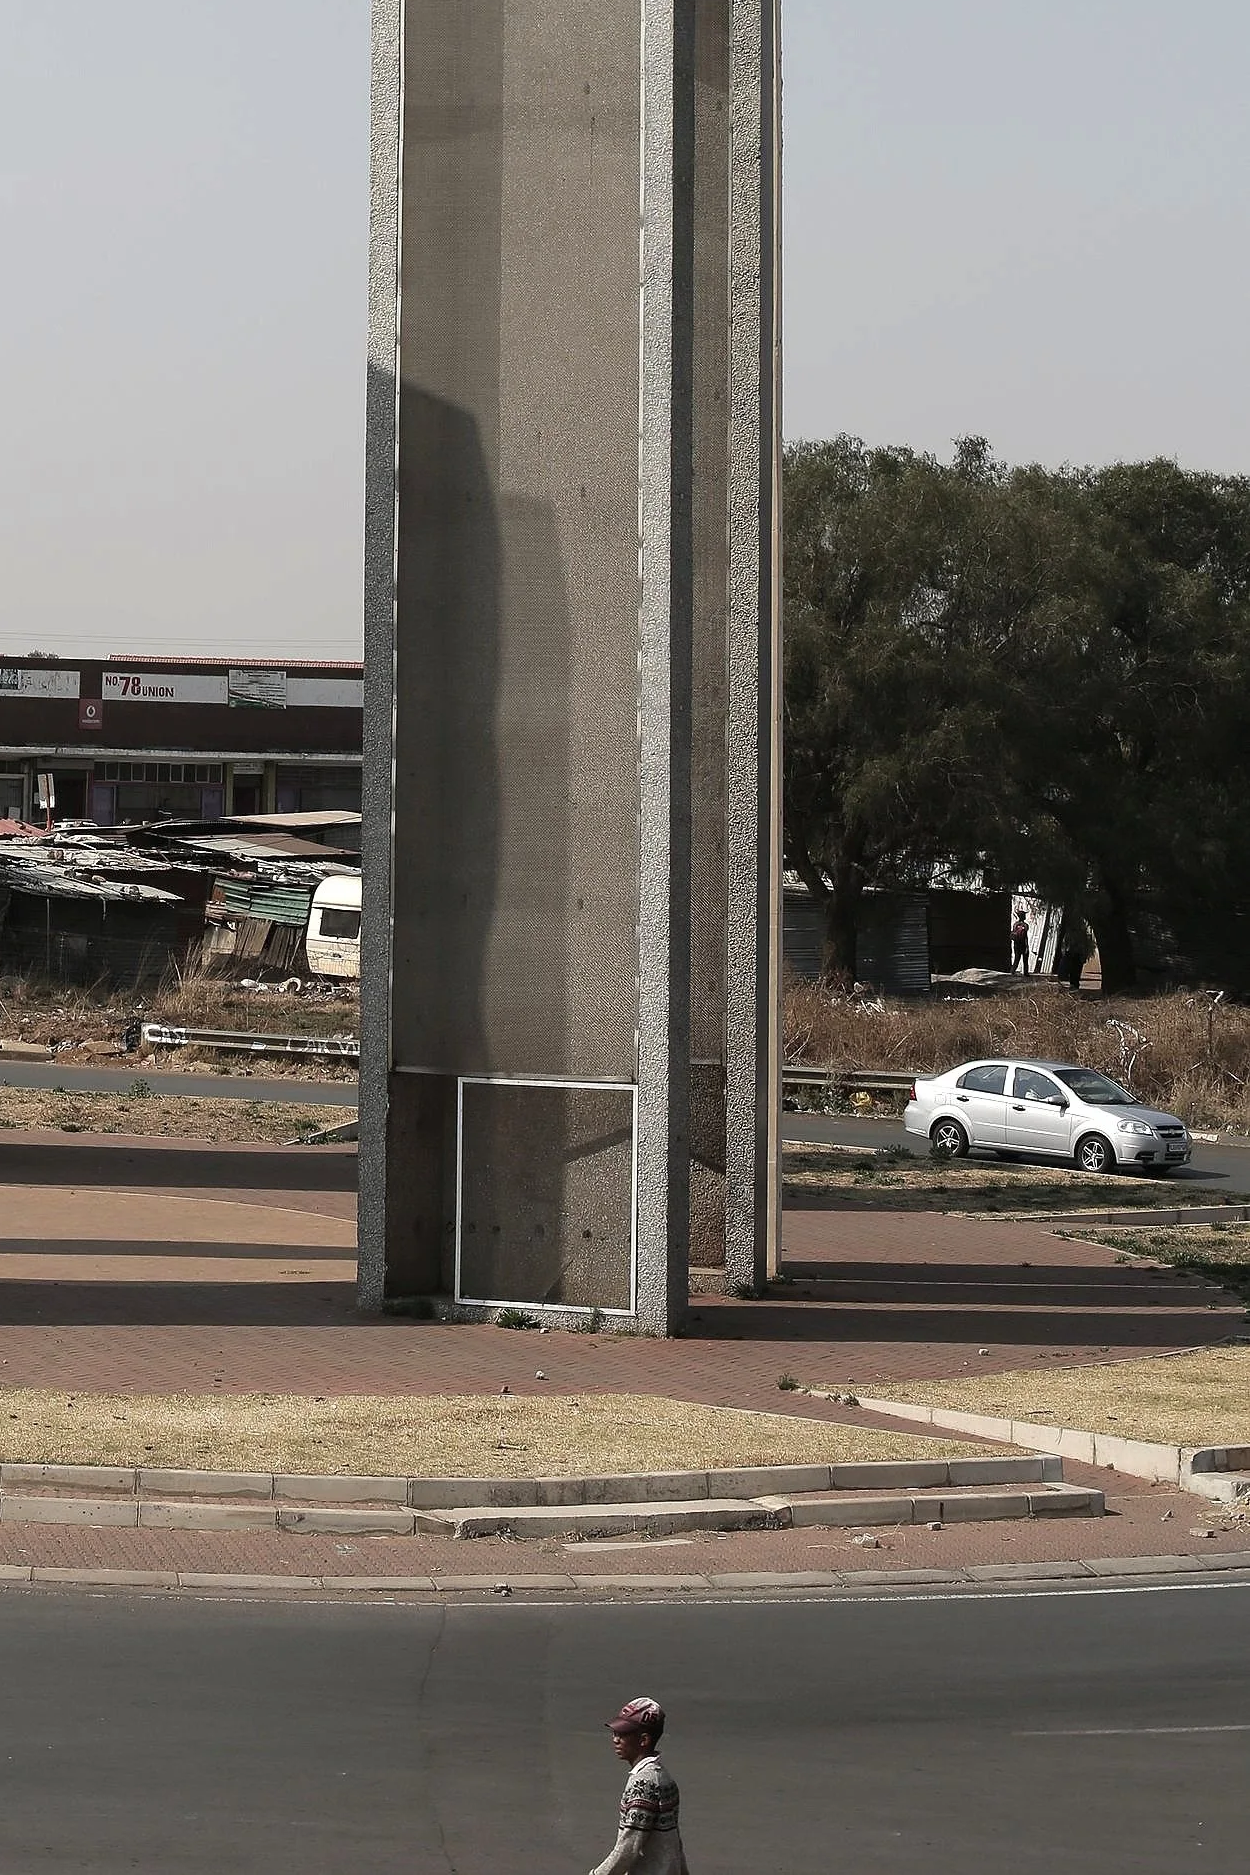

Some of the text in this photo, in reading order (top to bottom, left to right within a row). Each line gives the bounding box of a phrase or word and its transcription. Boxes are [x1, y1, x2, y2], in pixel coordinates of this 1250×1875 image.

[105, 676, 174, 697] NO. 78 UNION
